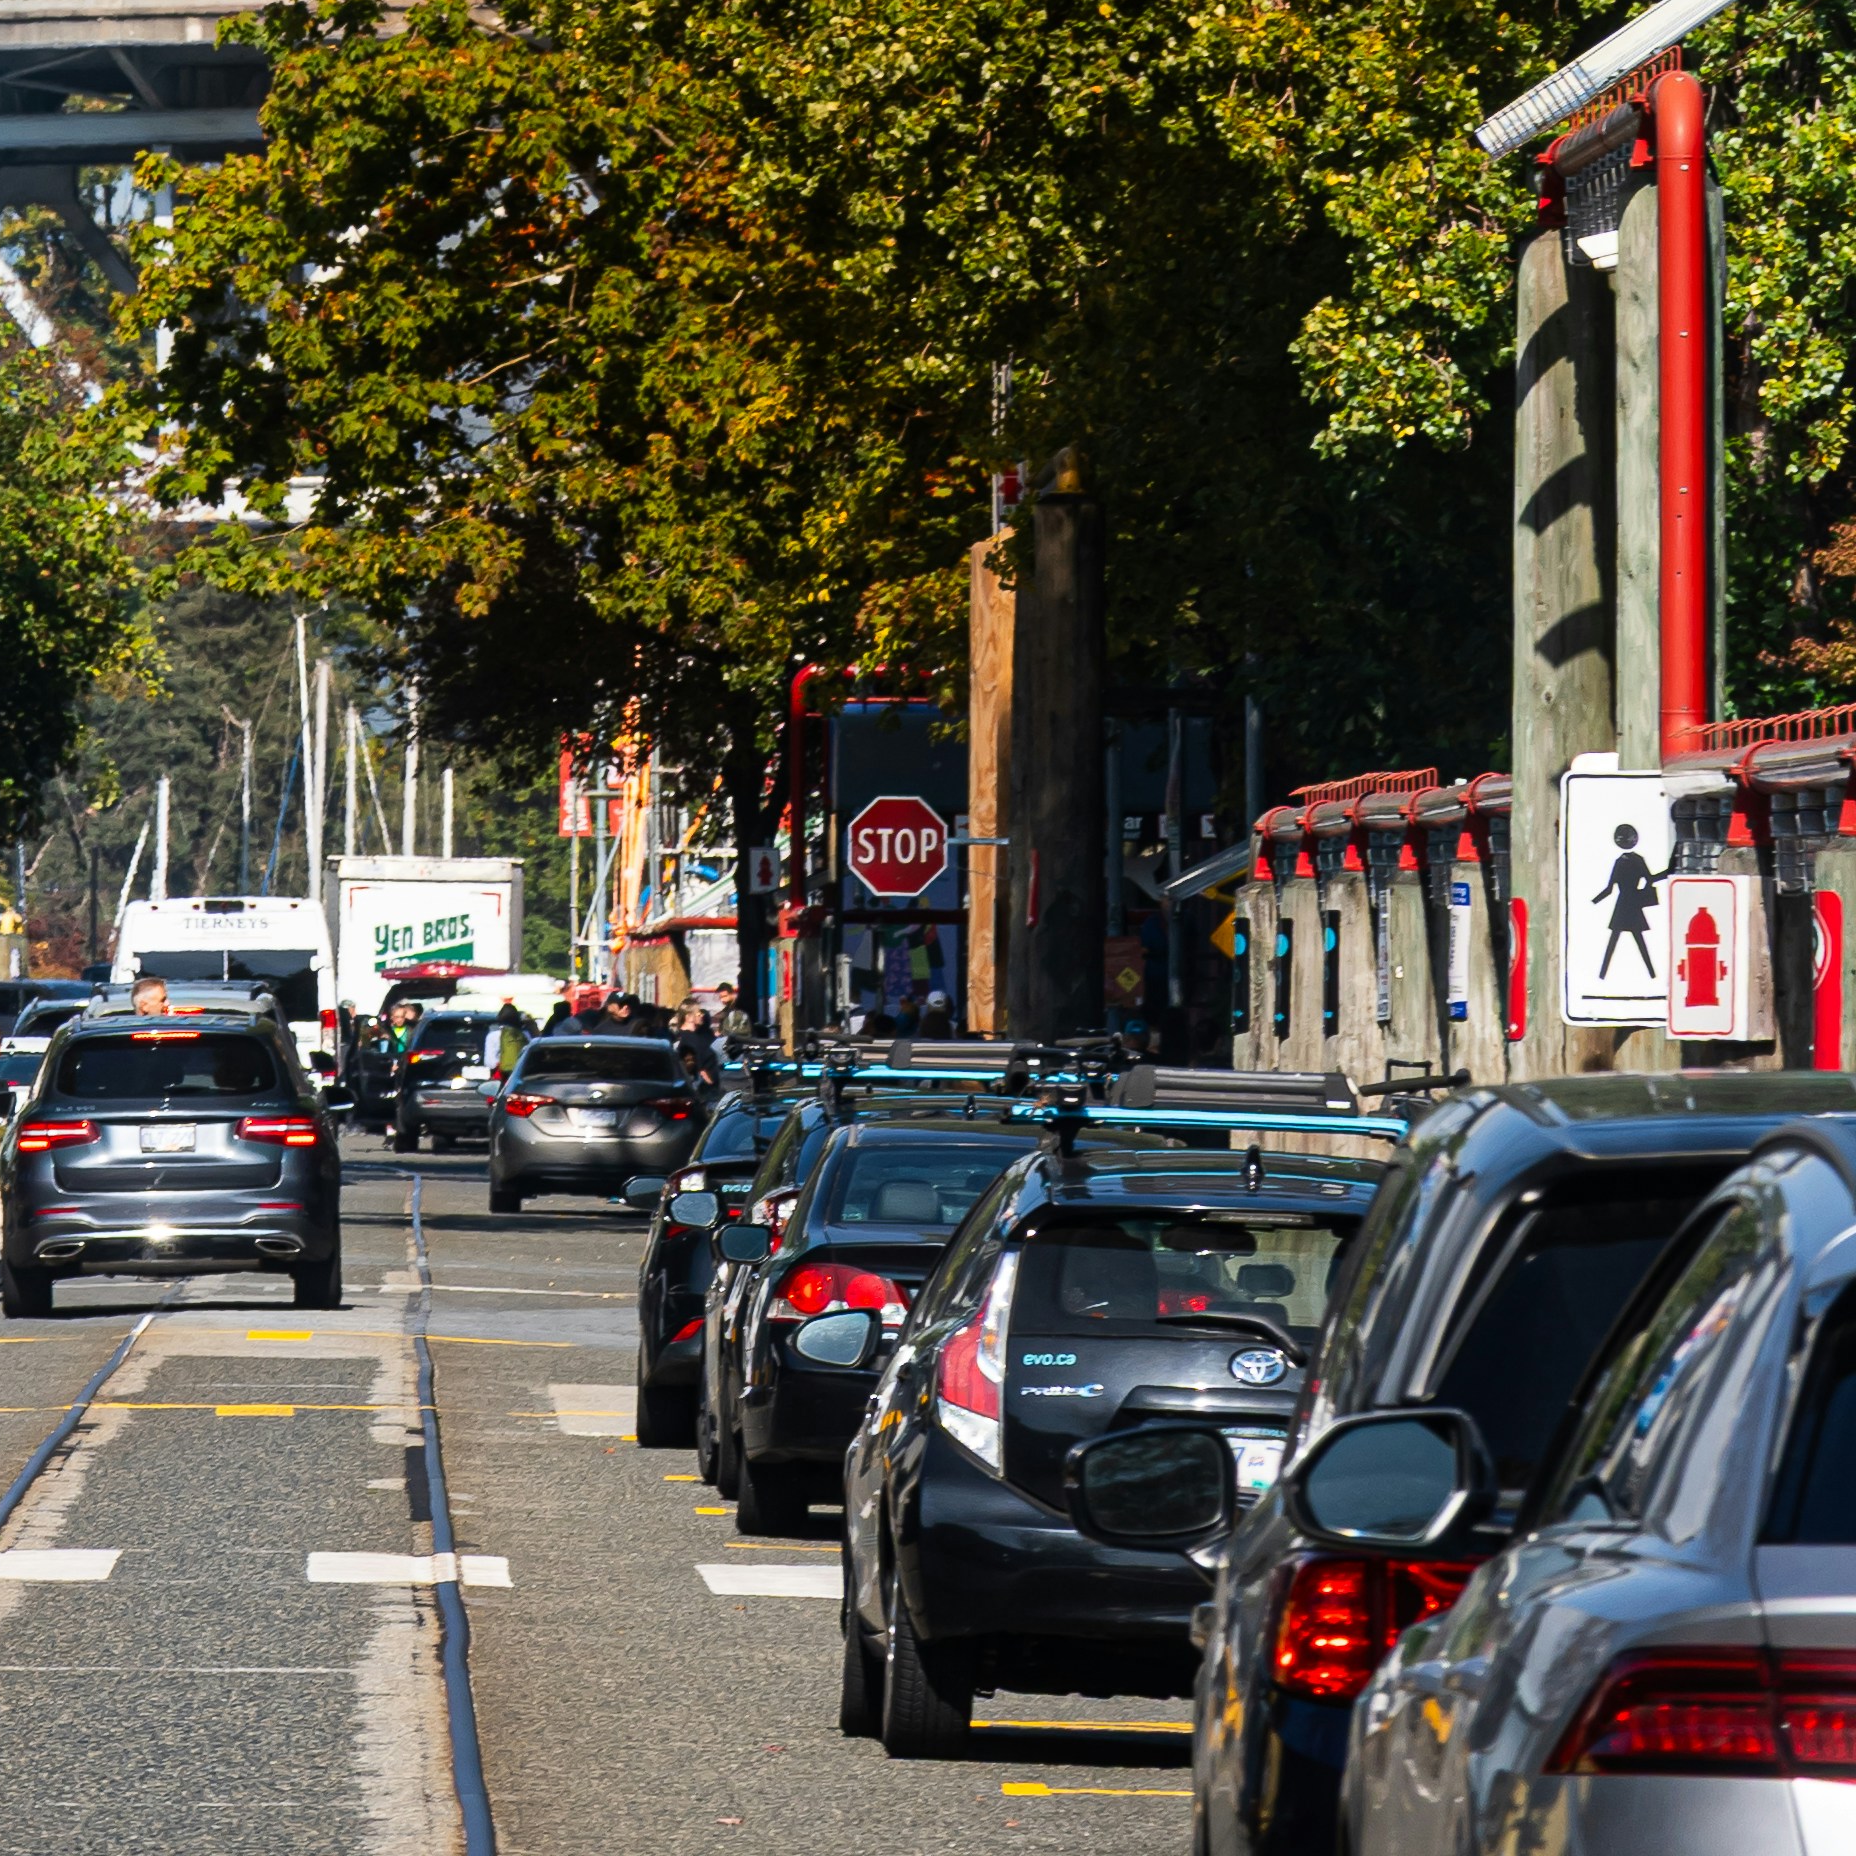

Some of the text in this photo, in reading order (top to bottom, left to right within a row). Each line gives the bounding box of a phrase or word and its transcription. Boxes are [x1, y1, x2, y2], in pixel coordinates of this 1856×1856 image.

[857, 828, 938, 864] STOP
[184, 918, 269, 929] TIERNEYS
[1023, 1352, 1077, 1366] evo.ca
